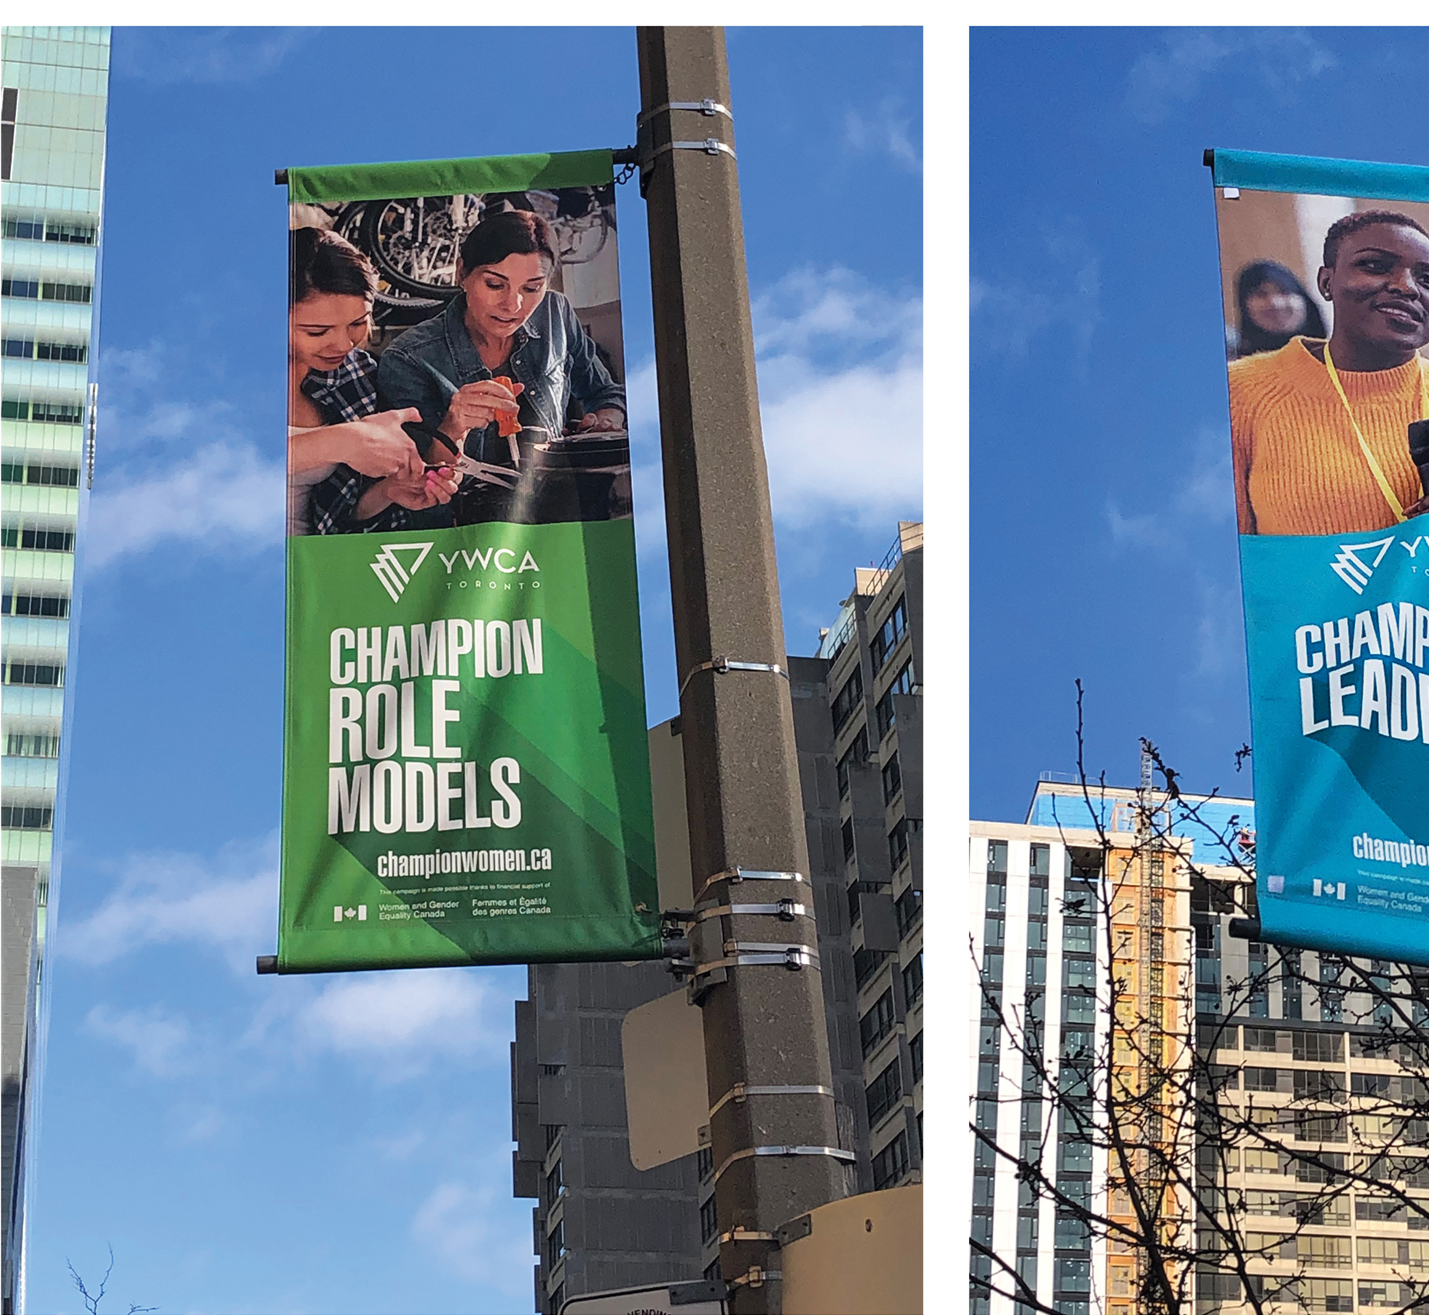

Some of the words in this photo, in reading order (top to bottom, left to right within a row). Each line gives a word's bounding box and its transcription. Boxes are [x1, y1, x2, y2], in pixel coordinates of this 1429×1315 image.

[438, 547, 540, 574] YWCA
[446, 580, 540, 590] TORONTO
[330, 618, 544, 685] CHAMPION
[329, 679, 462, 764] ROLE
[328, 756, 522, 835] MODELS
[377, 848, 552, 879] championwomen.ca
[393, 888, 420, 896] campaign
[444, 885, 468, 893] possible
[521, 882, 543, 890] support
[1358, 885, 1389, 897] Women
[1390, 890, 1405, 899] and
[379, 903, 410, 912] Women
[412, 901, 427, 910] and
[429, 900, 460, 909] Gender
[472, 898, 507, 907] Femmes
[509, 898, 517, 906] et
[519, 896, 547, 907] Égalité
[1357, 895, 1389, 909] Equality
[1390, 901, 1422, 913] Canada
[379, 911, 411, 921] Equality
[413, 910, 445, 919] Canada
[472, 908, 488, 916] des
[489, 908, 517, 917] genres
[519, 906, 551, 915] Canada
